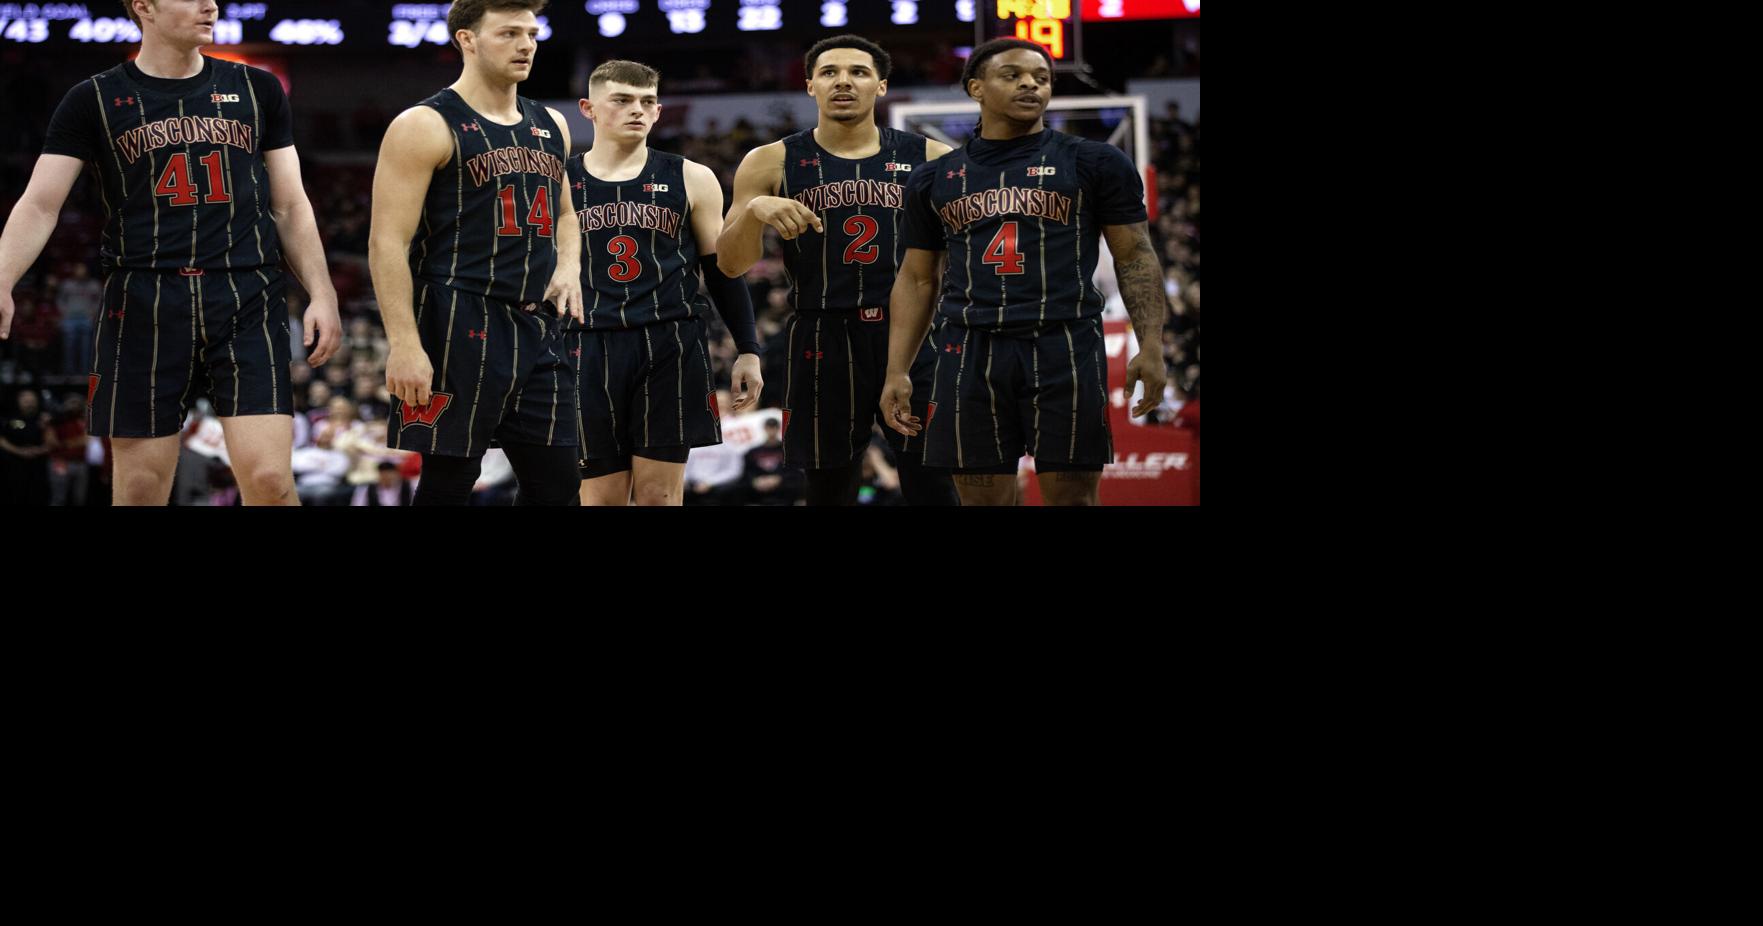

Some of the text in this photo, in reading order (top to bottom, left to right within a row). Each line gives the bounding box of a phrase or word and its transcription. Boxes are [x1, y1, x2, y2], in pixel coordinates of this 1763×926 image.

[116, 115, 253, 165] WISCONSIN
[154, 150, 233, 207] 41
[794, 179, 906, 213] WISCONSI
[497, 184, 553, 238] 14
[940, 186, 1072, 235] WISCONSIN
[607, 234, 642, 283] 3
[842, 214, 879, 265] 2
[982, 220, 1026, 276] 4
